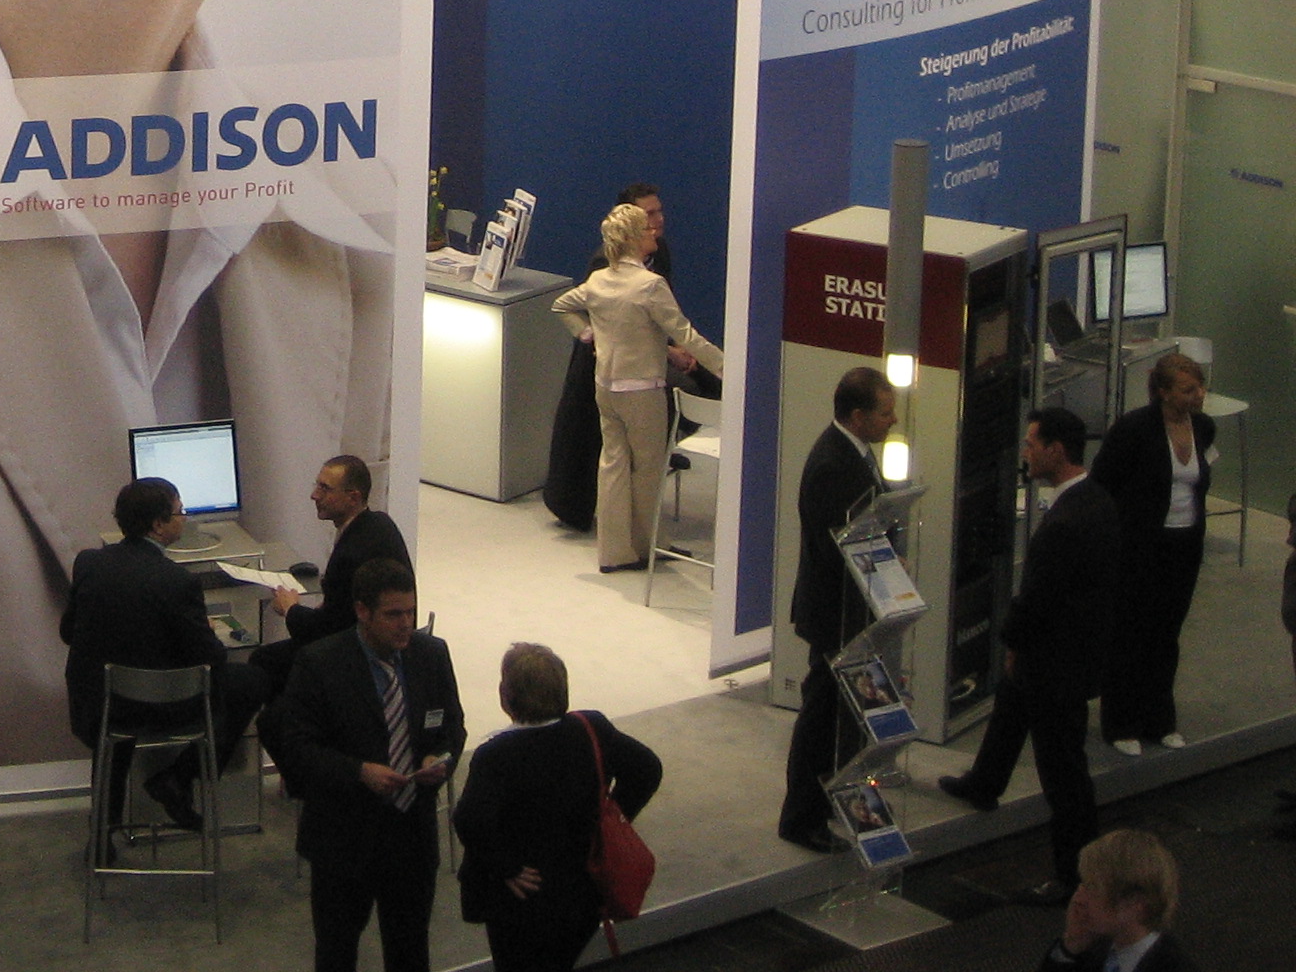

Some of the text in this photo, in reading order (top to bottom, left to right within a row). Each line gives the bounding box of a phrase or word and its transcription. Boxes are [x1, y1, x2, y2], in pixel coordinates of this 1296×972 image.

[802, 0, 905, 35] Consulting
[919, 43, 989, 77] Steigerung
[990, 37, 1009, 58] der
[945, 108, 987, 133] Analyse
[987, 102, 1008, 121] und
[0, 98, 378, 185] ADDISON
[944, 130, 1003, 162] Umsetzung
[1, 195, 86, 215] Software
[92, 193, 111, 208] to
[117, 190, 192, 208] manage
[197, 186, 239, 206] your
[245, 180, 295, 199] Profit
